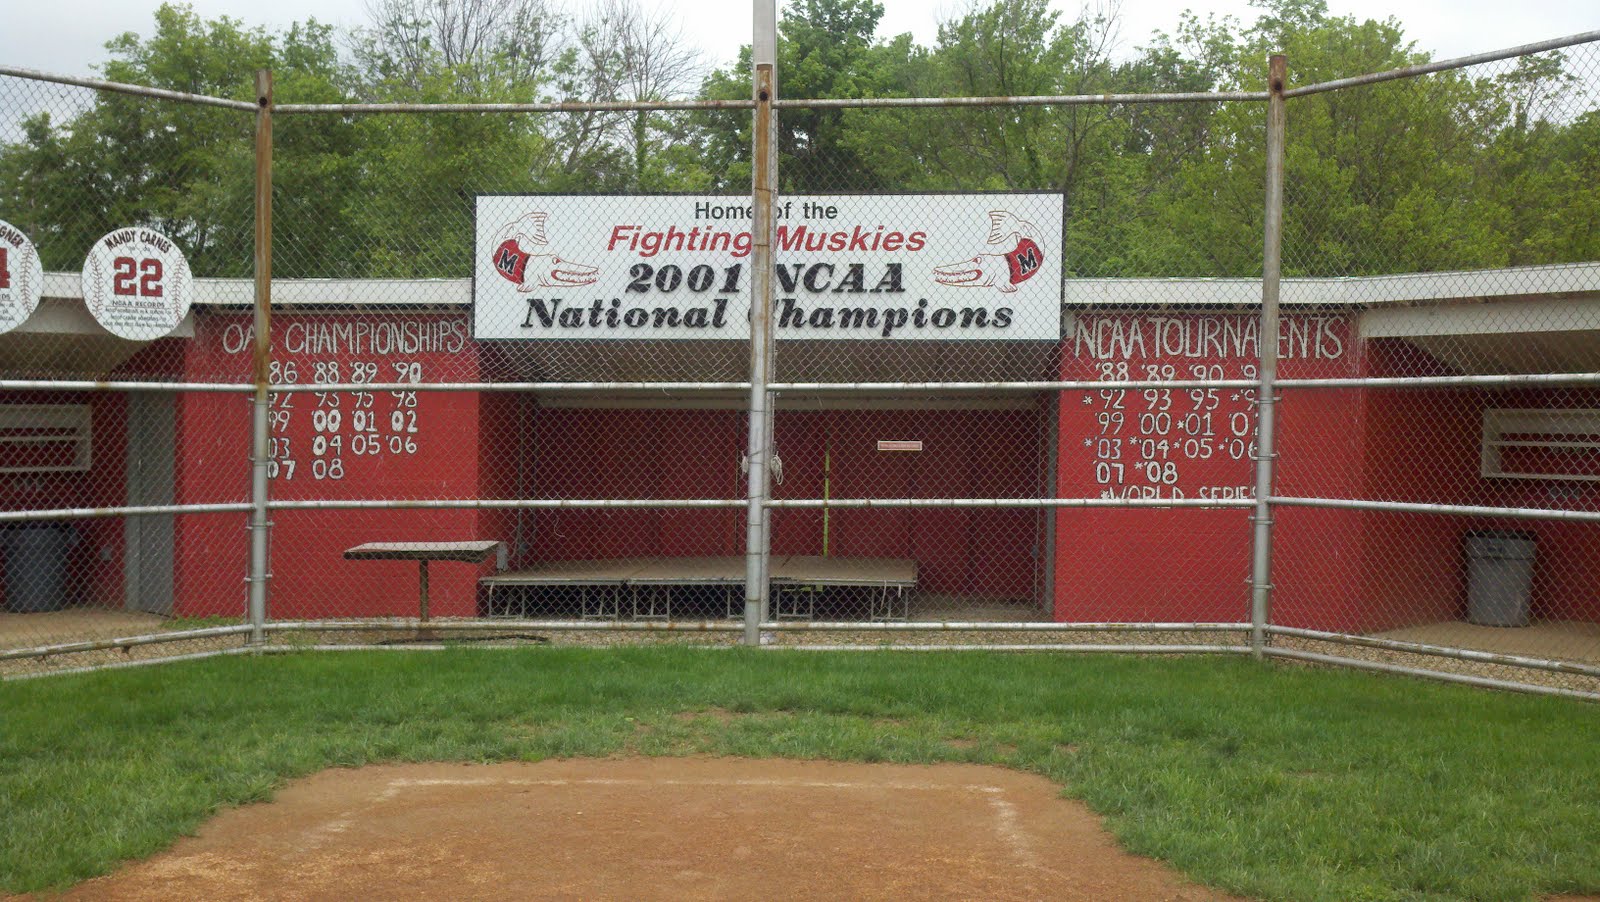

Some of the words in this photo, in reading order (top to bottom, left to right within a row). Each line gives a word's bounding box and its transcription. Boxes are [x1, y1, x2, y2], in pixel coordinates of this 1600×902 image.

[695, 201, 752, 219] Home
[803, 201, 838, 219] the
[104, 230, 136, 250] MANDY
[140, 231, 171, 253] CARNES
[607, 225, 752, 257] Fighting
[775, 225, 927, 251] Muskies
[113, 256, 163, 297] 22
[498, 250, 518, 275] M
[1017, 249, 1037, 275] M
[625, 263, 742, 293] 2001
[776, 263, 906, 293] NCAA
[520, 298, 728, 328] National
[748, 298, 1013, 337] hampions
[285, 320, 464, 354] CHAMPIONSHIPS
[1075, 318, 1147, 359] NCAA
[1149, 316, 1343, 359] TOURNAENTS
